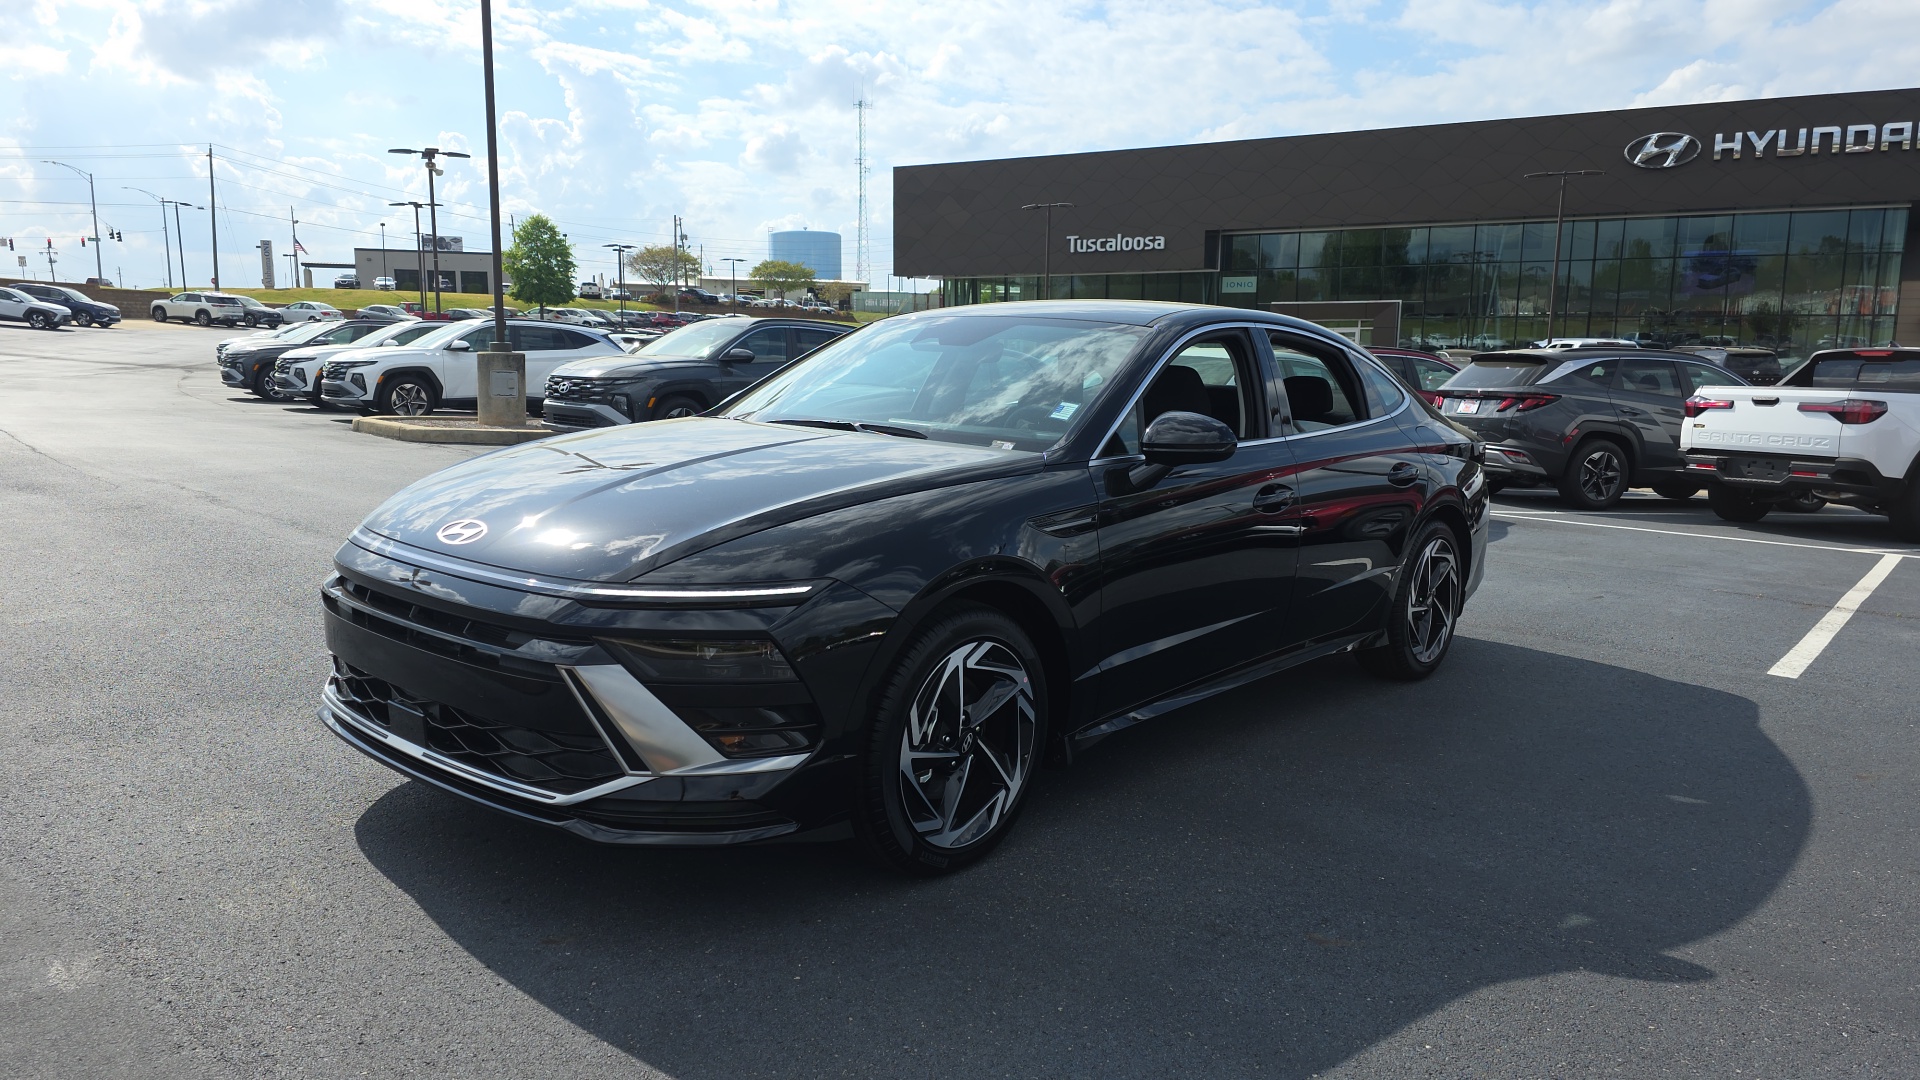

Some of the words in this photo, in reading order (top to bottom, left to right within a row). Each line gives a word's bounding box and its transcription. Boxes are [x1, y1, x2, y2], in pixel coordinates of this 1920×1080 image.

[263, 240, 271, 257] ONE
[1066, 233, 1165, 253] Tuscaloosa
[1699, 431, 1762, 445] SANTA
[1767, 434, 1830, 449] CRUZ
